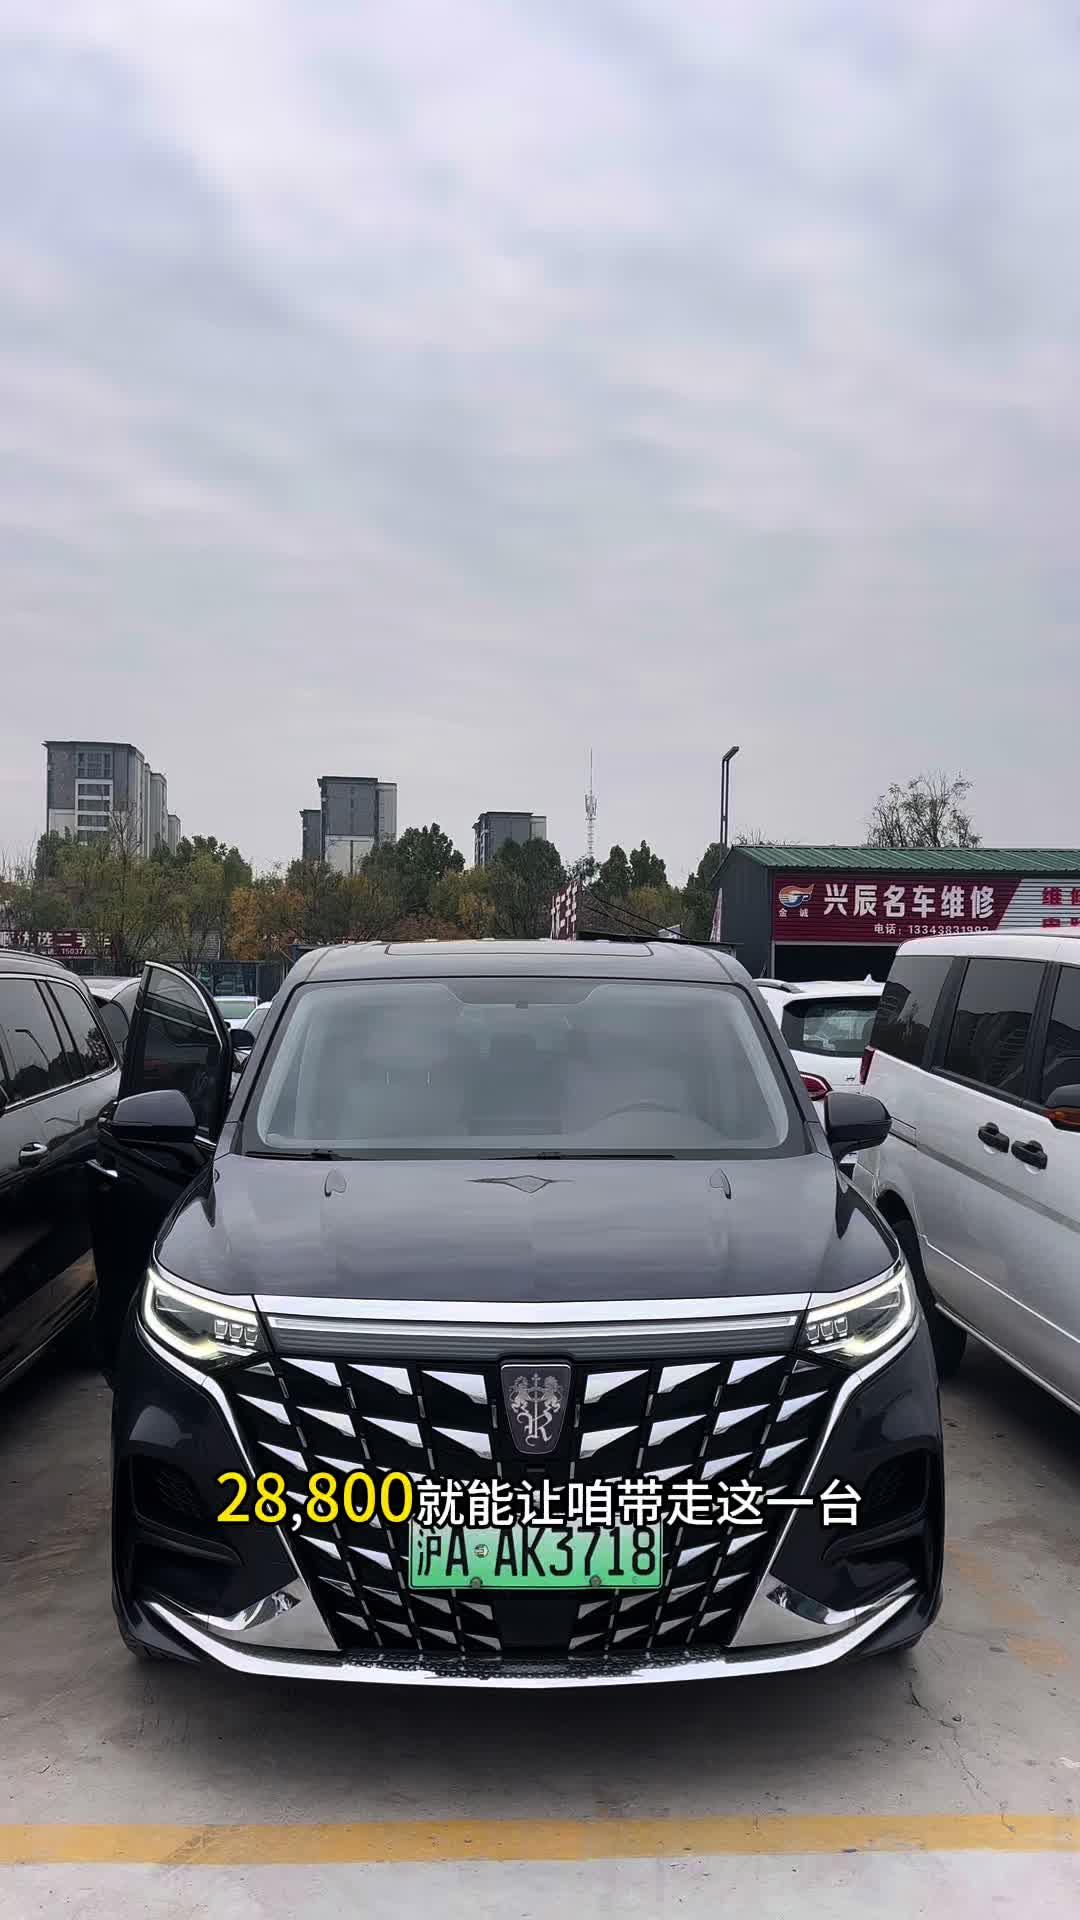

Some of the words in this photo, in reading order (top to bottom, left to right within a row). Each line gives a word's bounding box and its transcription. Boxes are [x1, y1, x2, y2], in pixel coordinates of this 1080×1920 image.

[823, 883, 995, 919] 兴辰名车维修
